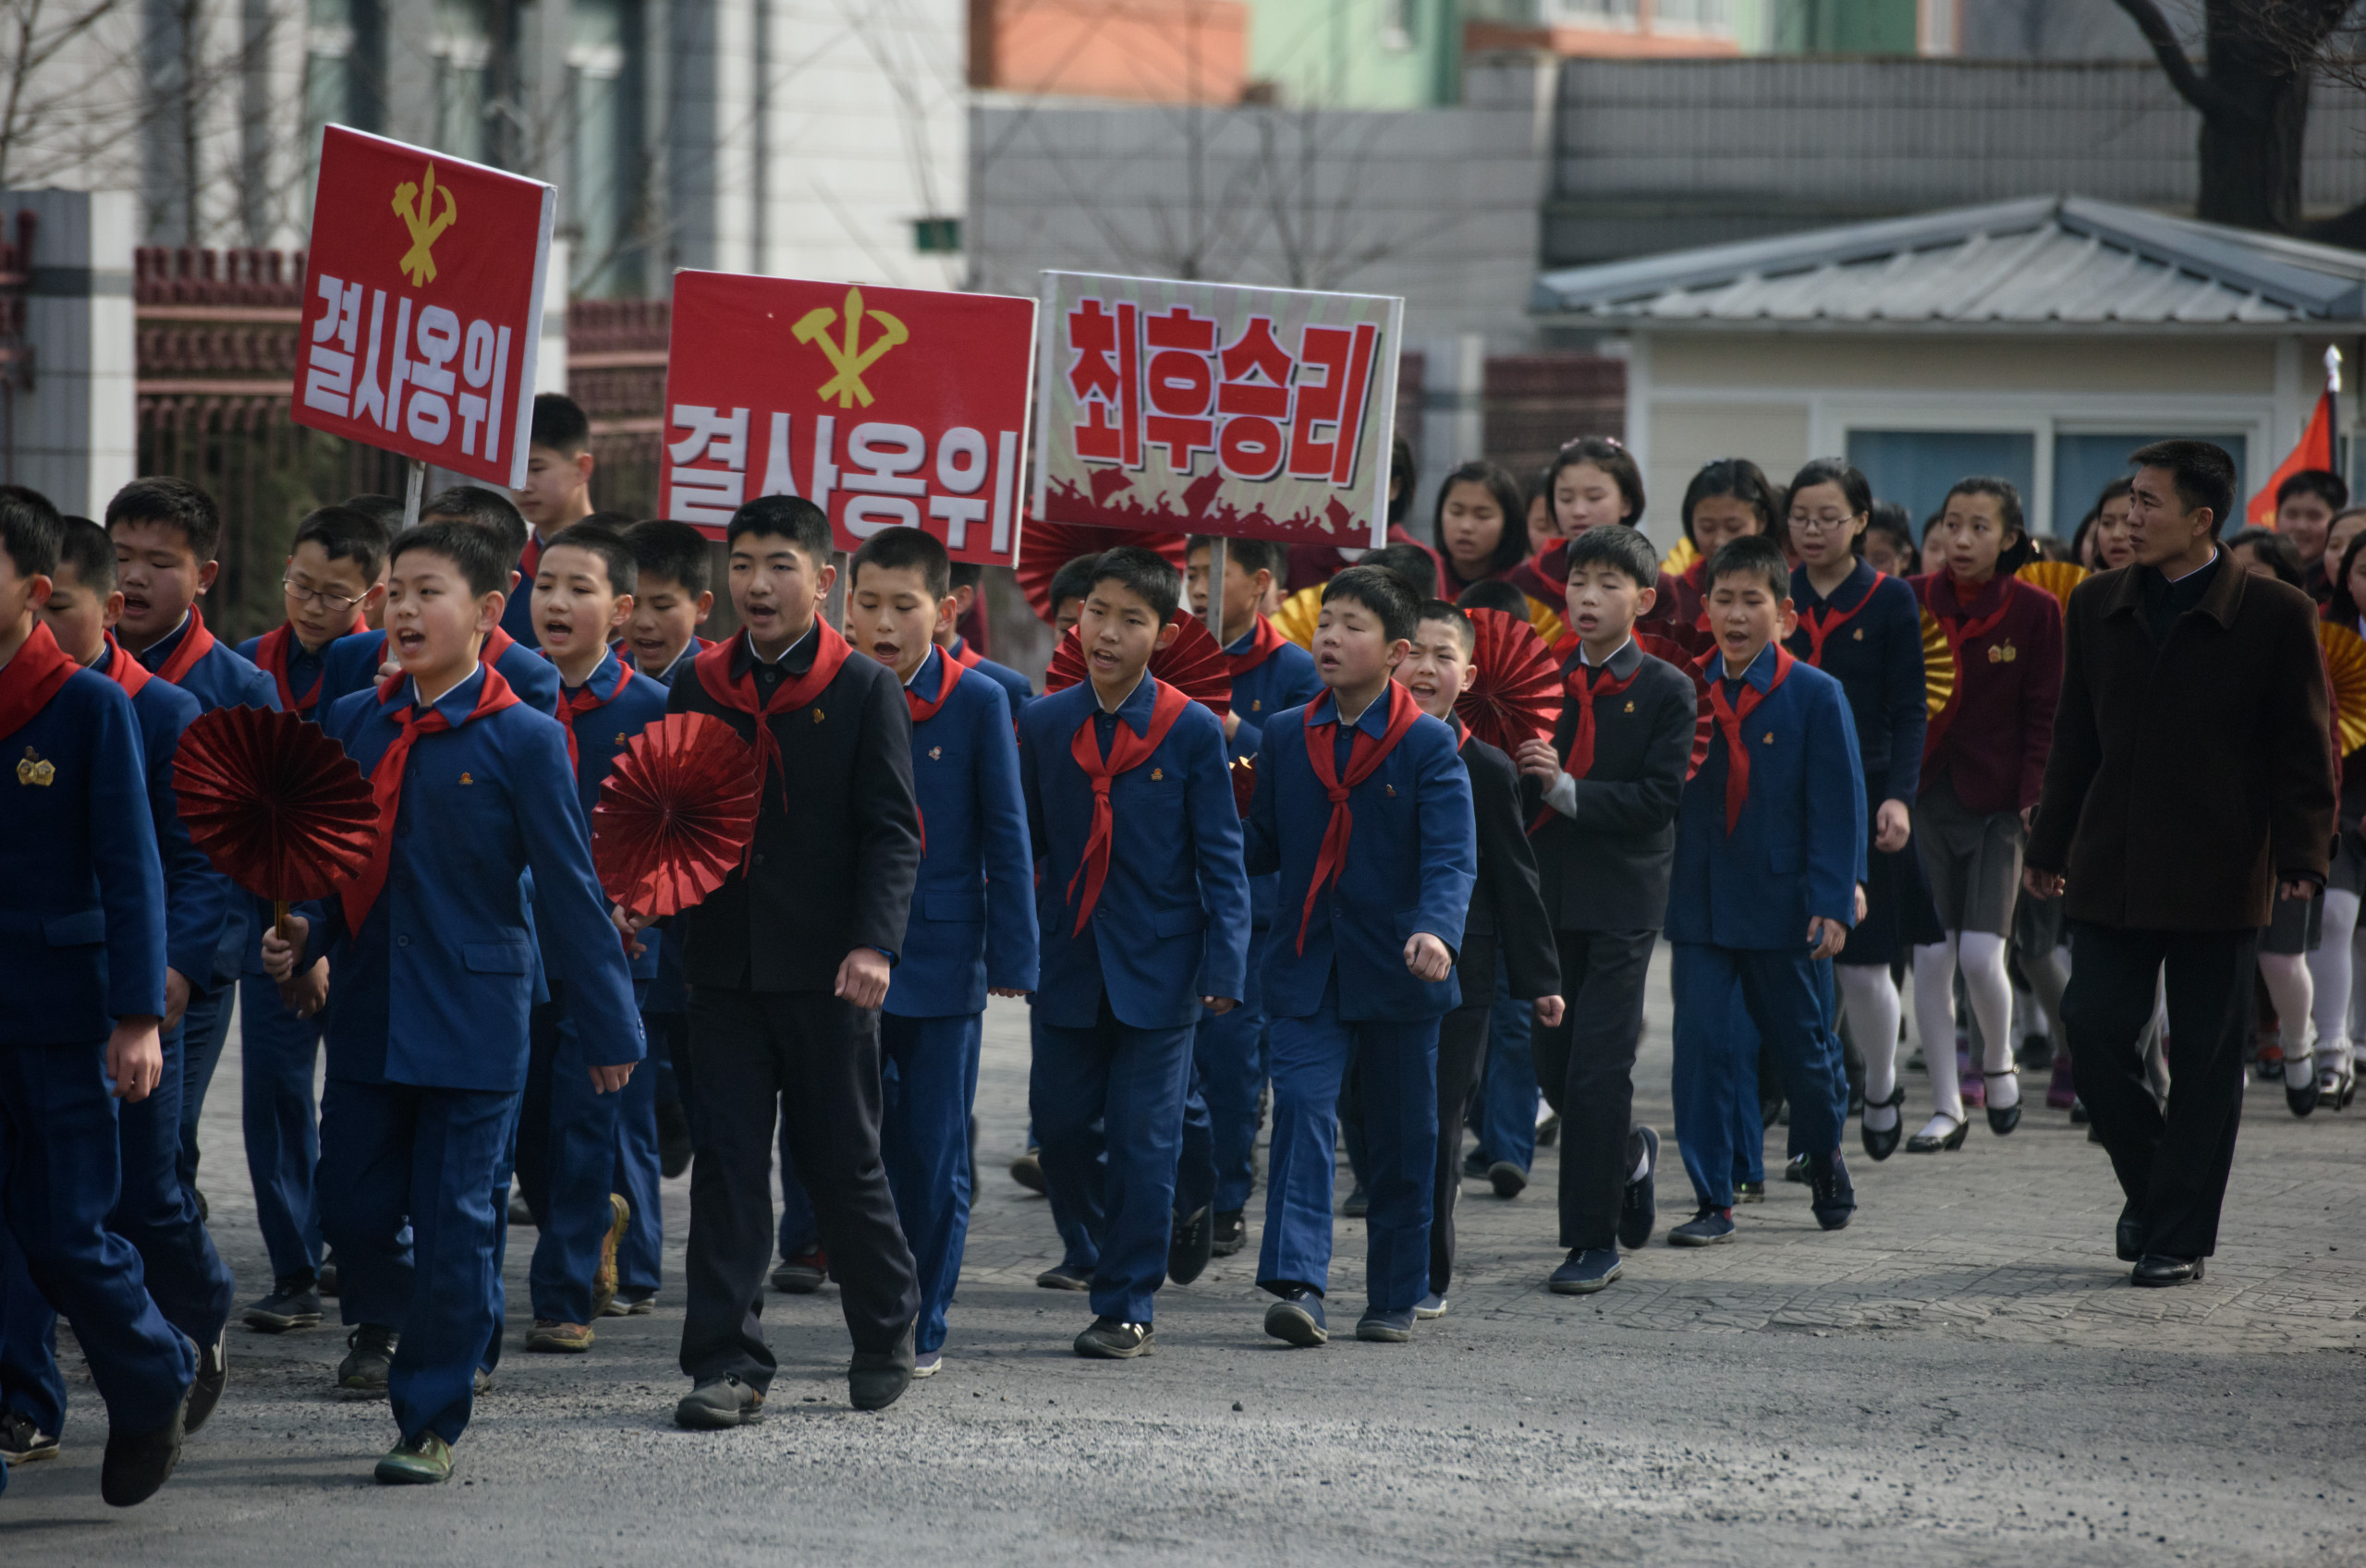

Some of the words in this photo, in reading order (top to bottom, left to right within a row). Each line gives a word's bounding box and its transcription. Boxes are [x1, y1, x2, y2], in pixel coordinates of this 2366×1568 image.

[304, 273, 512, 463] 결사옹위
[1067, 297, 1379, 487] 최후승리
[667, 404, 1018, 553] 결사옹위
